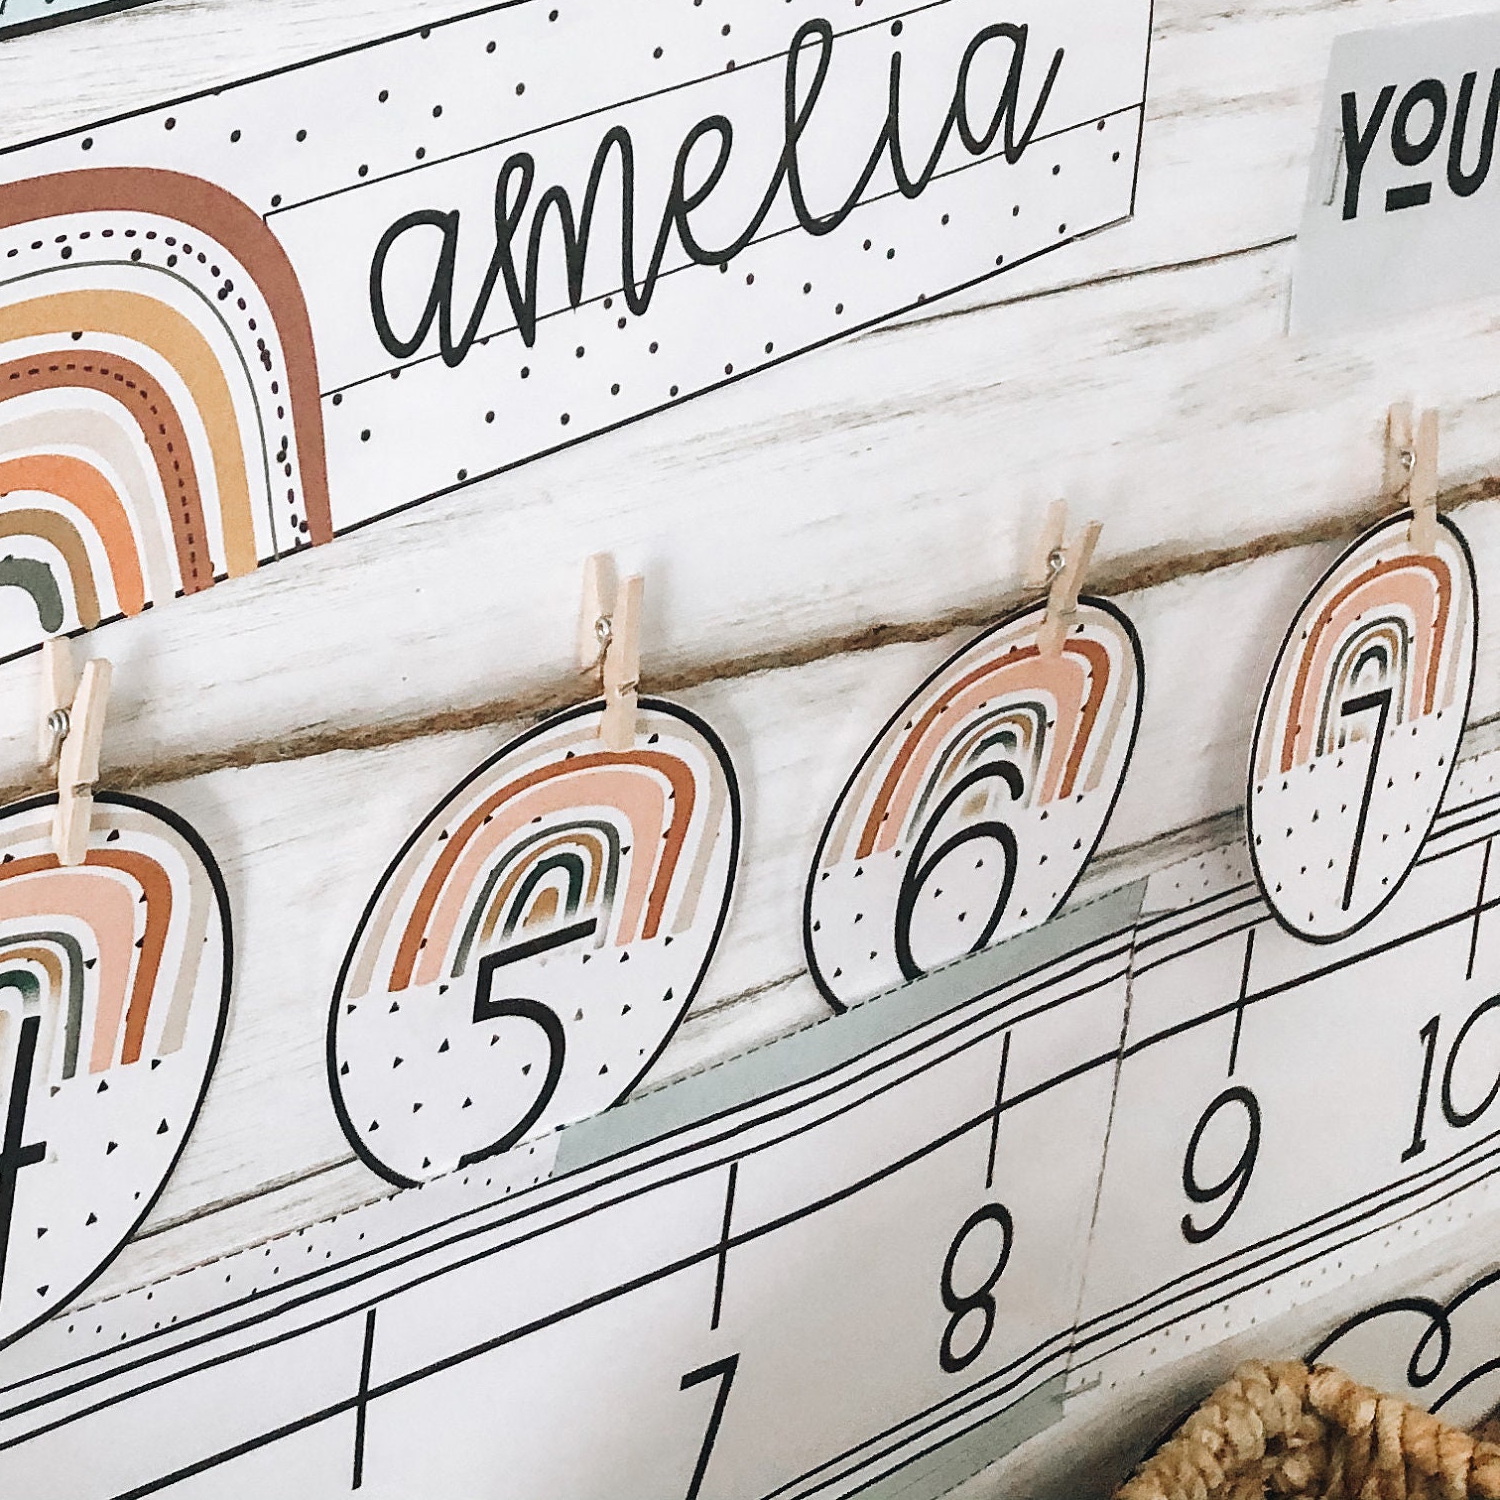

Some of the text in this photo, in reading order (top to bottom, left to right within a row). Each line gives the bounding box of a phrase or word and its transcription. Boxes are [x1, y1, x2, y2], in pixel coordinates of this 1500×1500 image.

[369, 17, 1065, 369] amelia
[1340, 66, 1500, 222] YOU
[894, 760, 1024, 981] 6
[1341, 686, 1393, 912] 7
[460, 917, 597, 1166] 5
[939, 1202, 1014, 1374] 8
[1180, 1085, 1262, 1244] 9
[1400, 995, 1500, 1163] 10
